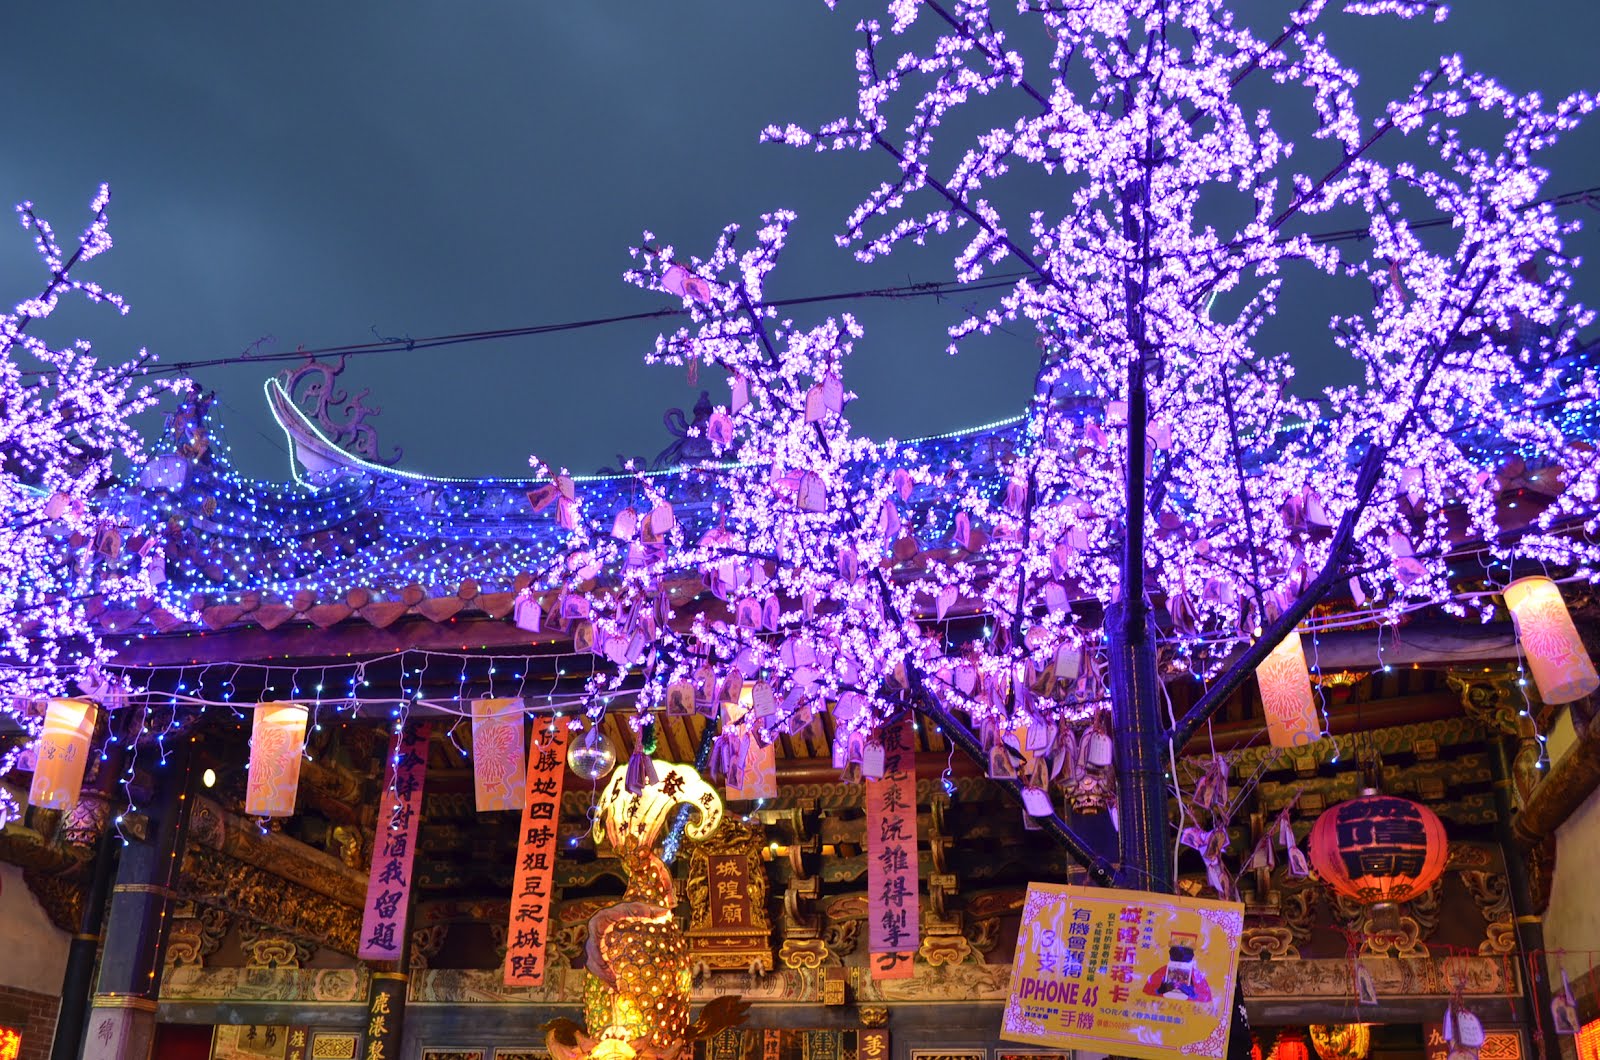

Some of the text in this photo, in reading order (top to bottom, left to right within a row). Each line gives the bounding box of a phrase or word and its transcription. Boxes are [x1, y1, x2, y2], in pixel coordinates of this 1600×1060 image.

[715, 859, 744, 924] 城隍廟
[1062, 907, 1093, 979] 有機會獲得
[1108, 906, 1144, 1004] 城隍祈福卡
[1018, 977, 1099, 1008] IPHONE 4S
[1059, 1010, 1095, 1031] 手機
